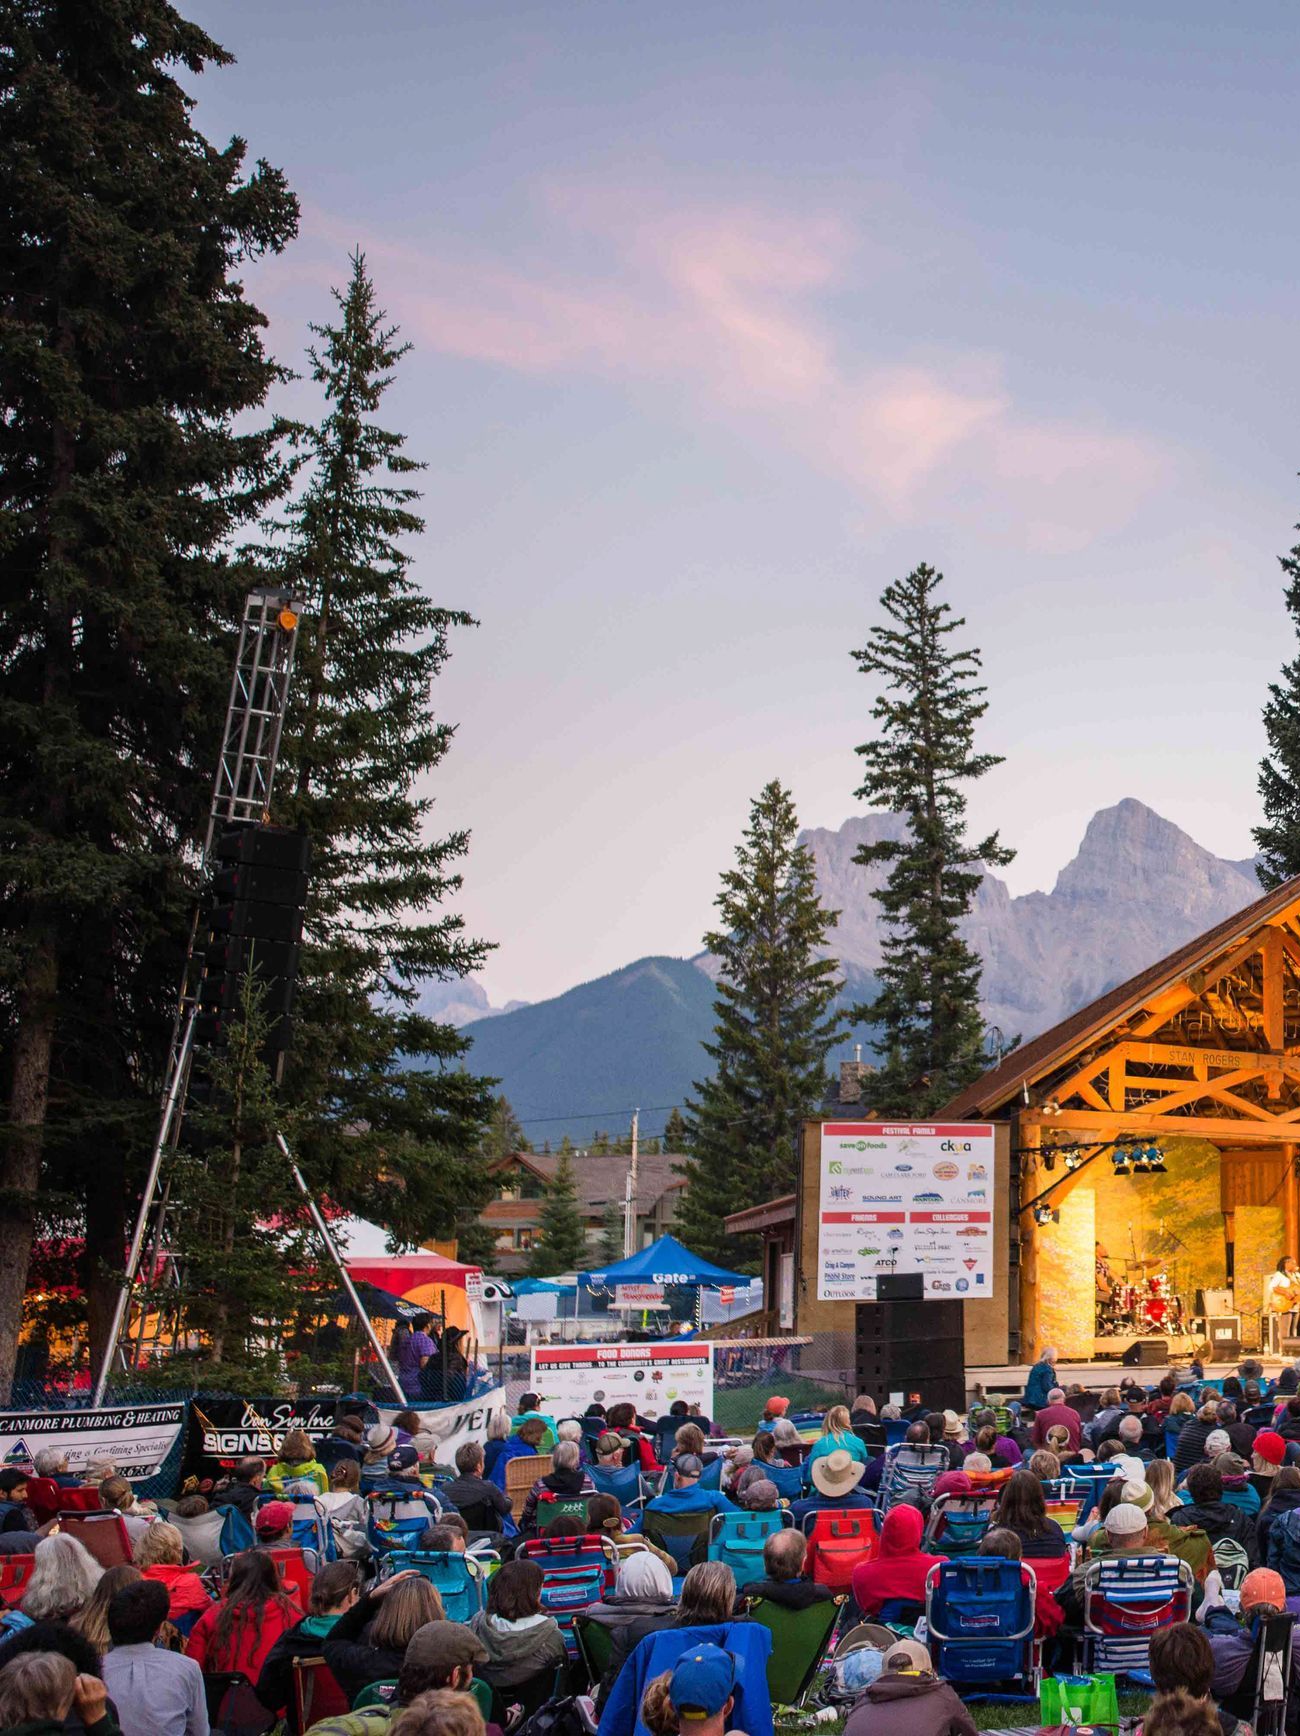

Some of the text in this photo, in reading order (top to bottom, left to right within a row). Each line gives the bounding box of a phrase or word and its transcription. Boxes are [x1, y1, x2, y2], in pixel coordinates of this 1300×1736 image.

[1168, 1051, 1241, 1067] STAN ROGERS
[882, 1127, 936, 1135] FESTIVAL FAMILY
[940, 1139, 971, 1151] ckua
[653, 1273, 688, 1284] Gate
[597, 1349, 618, 1359] FOOD
[0, 1409, 181, 1432] CANMORE PLUMBING & HEATING
[307, 1404, 334, 1428] Inc
[203, 1433, 273, 1452] SIGNS
